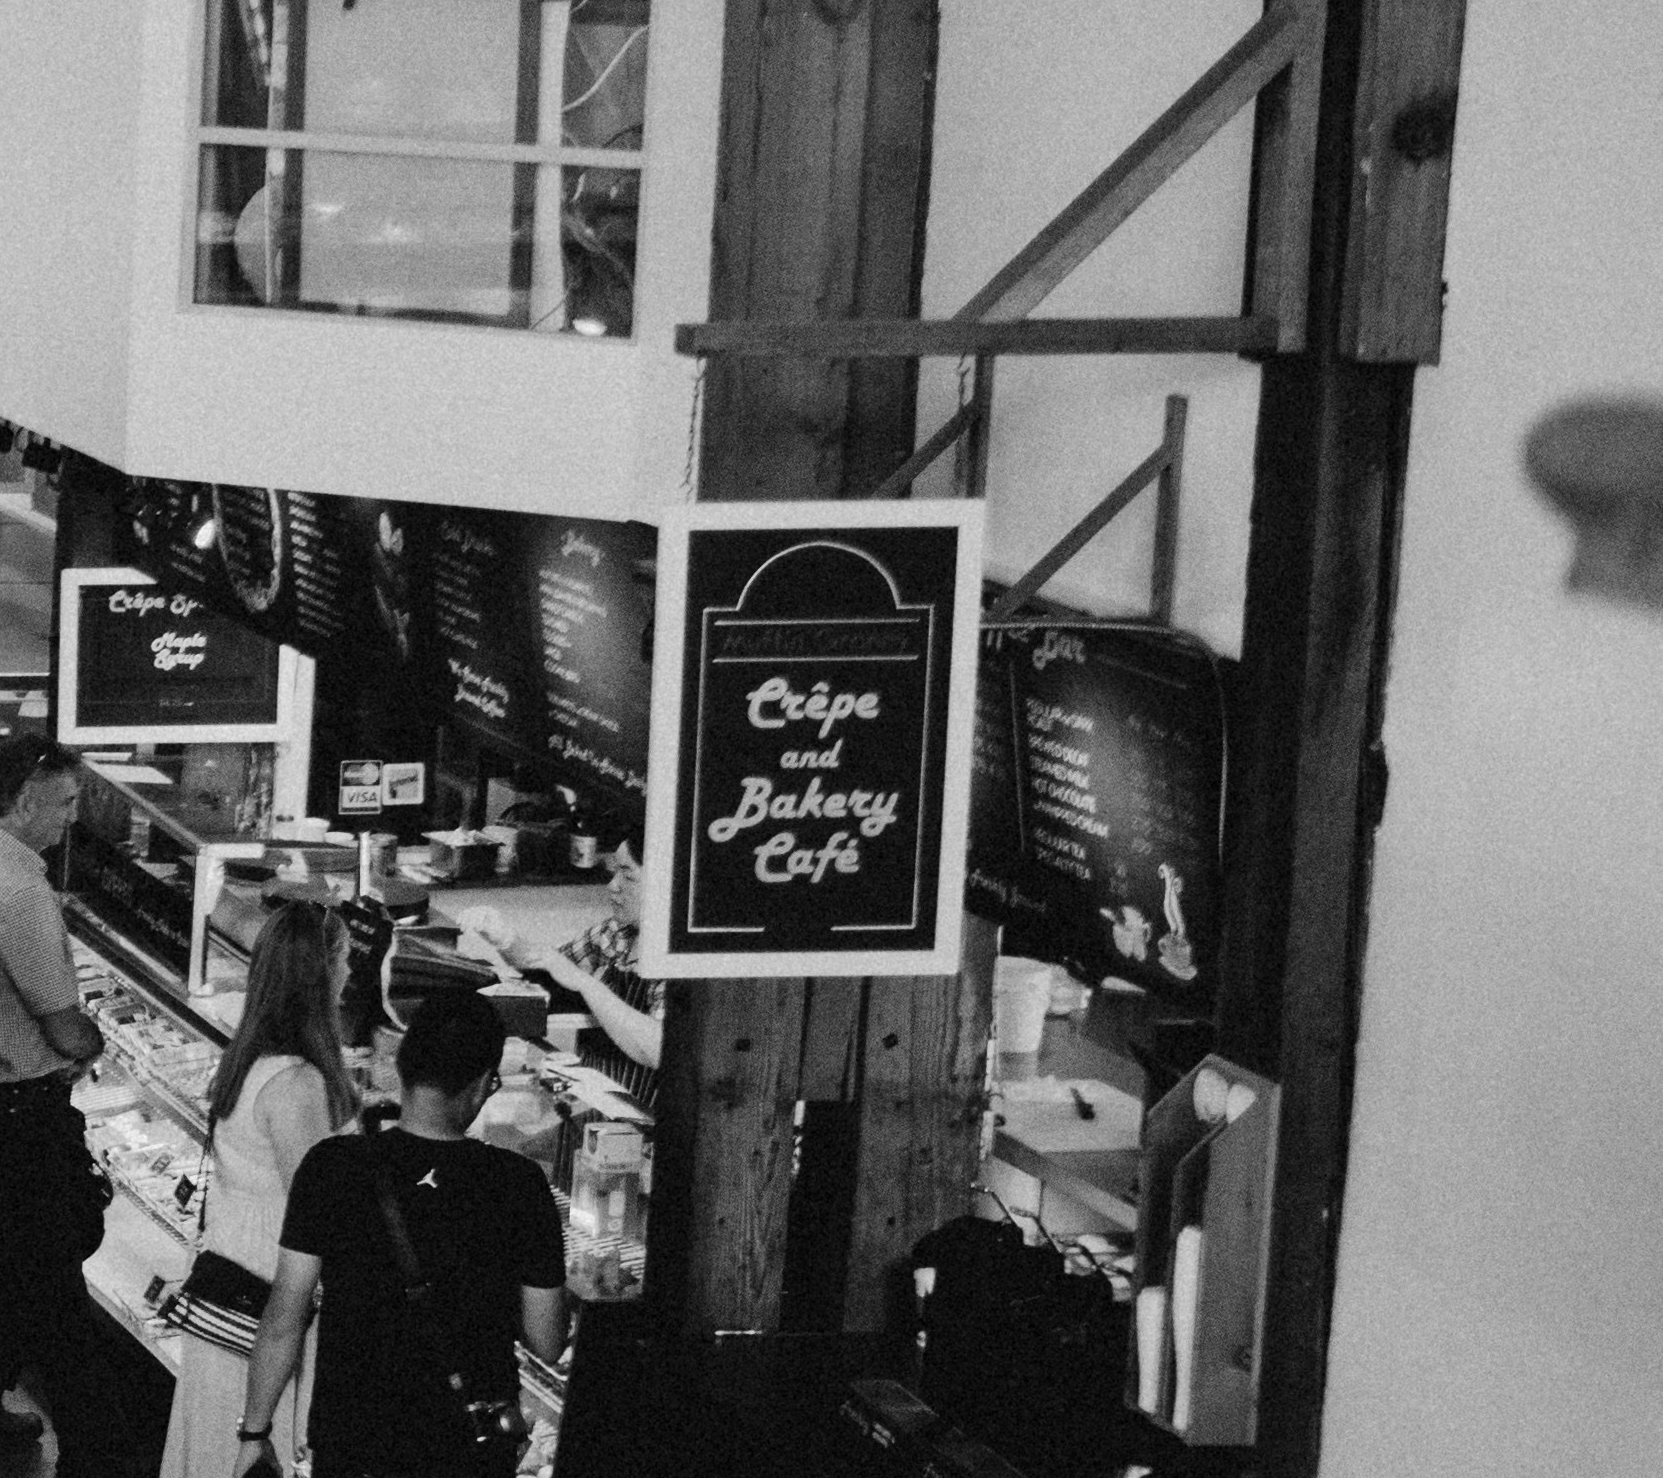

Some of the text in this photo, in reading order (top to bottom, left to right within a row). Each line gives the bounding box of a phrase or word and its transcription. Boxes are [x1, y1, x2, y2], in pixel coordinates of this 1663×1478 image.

[108, 589, 166, 617] Crêpe
[745, 676, 881, 739] Crêpe
[779, 737, 844, 769] and
[348, 791, 378, 803] VISA
[707, 776, 899, 843] Bakery
[753, 831, 861, 884] Café
